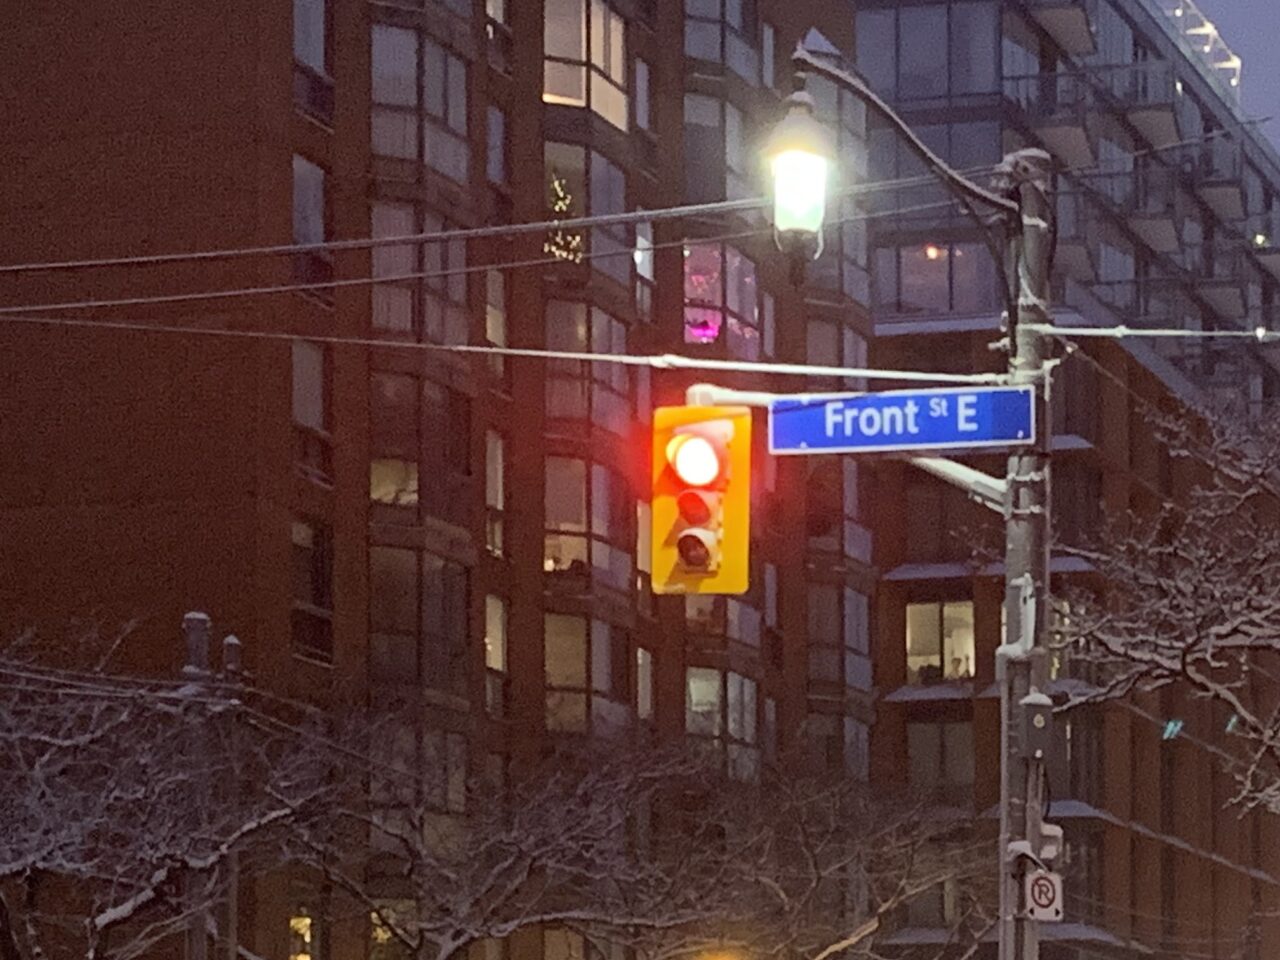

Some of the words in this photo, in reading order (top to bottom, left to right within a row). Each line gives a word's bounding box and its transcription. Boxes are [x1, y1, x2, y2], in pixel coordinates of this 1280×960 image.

[825, 400, 920, 437] Front
[929, 397, 949, 417] St
[957, 395, 979, 432] E
